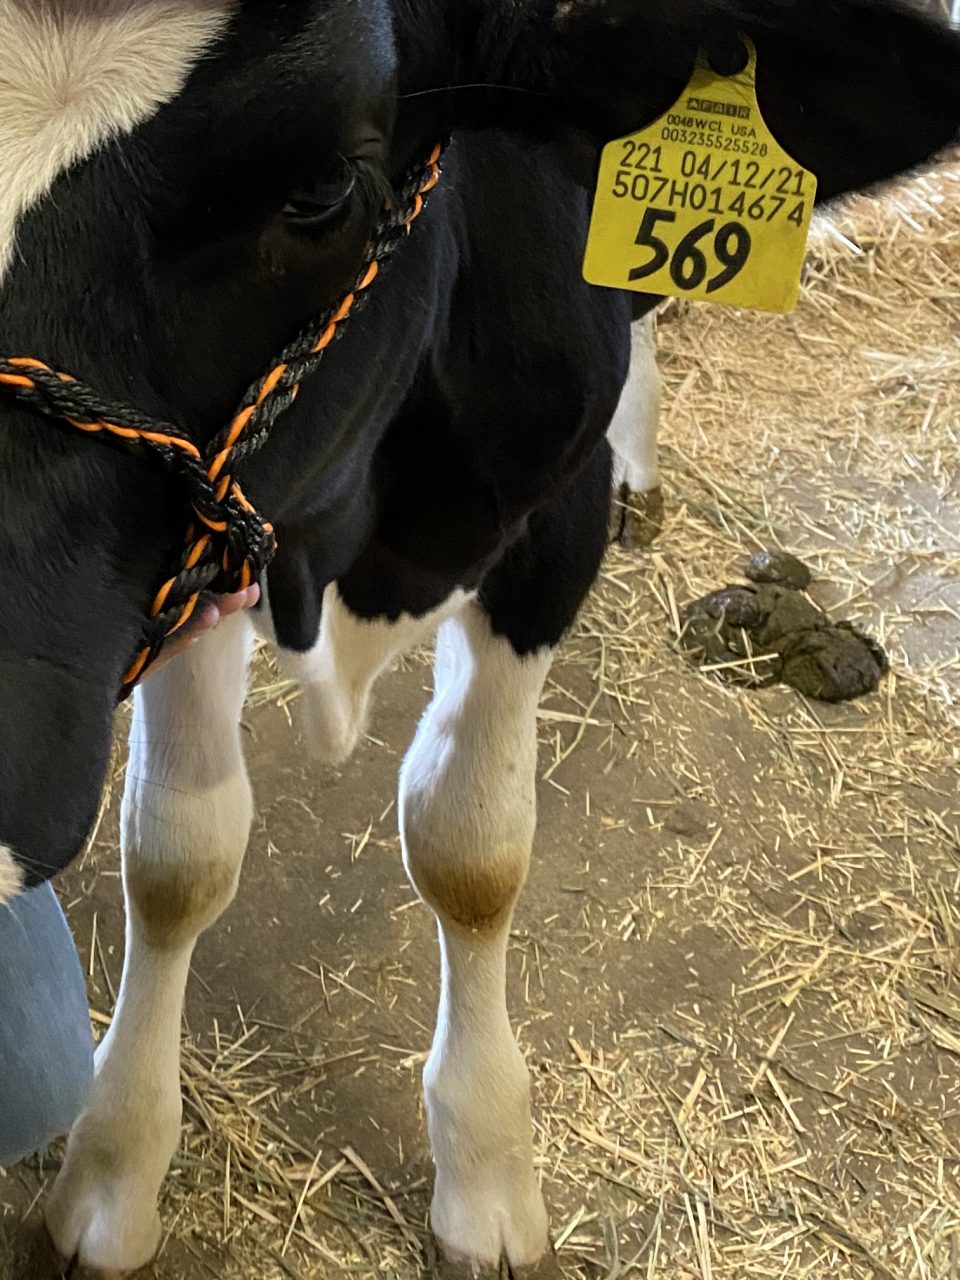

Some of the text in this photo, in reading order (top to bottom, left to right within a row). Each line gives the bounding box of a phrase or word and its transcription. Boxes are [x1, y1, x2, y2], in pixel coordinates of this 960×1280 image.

[661, 127, 768, 158] 003235525528
[731, 124, 757, 139] USA
[619, 140, 806, 197] 221 04/12/21
[627, 206, 752, 294] 569
